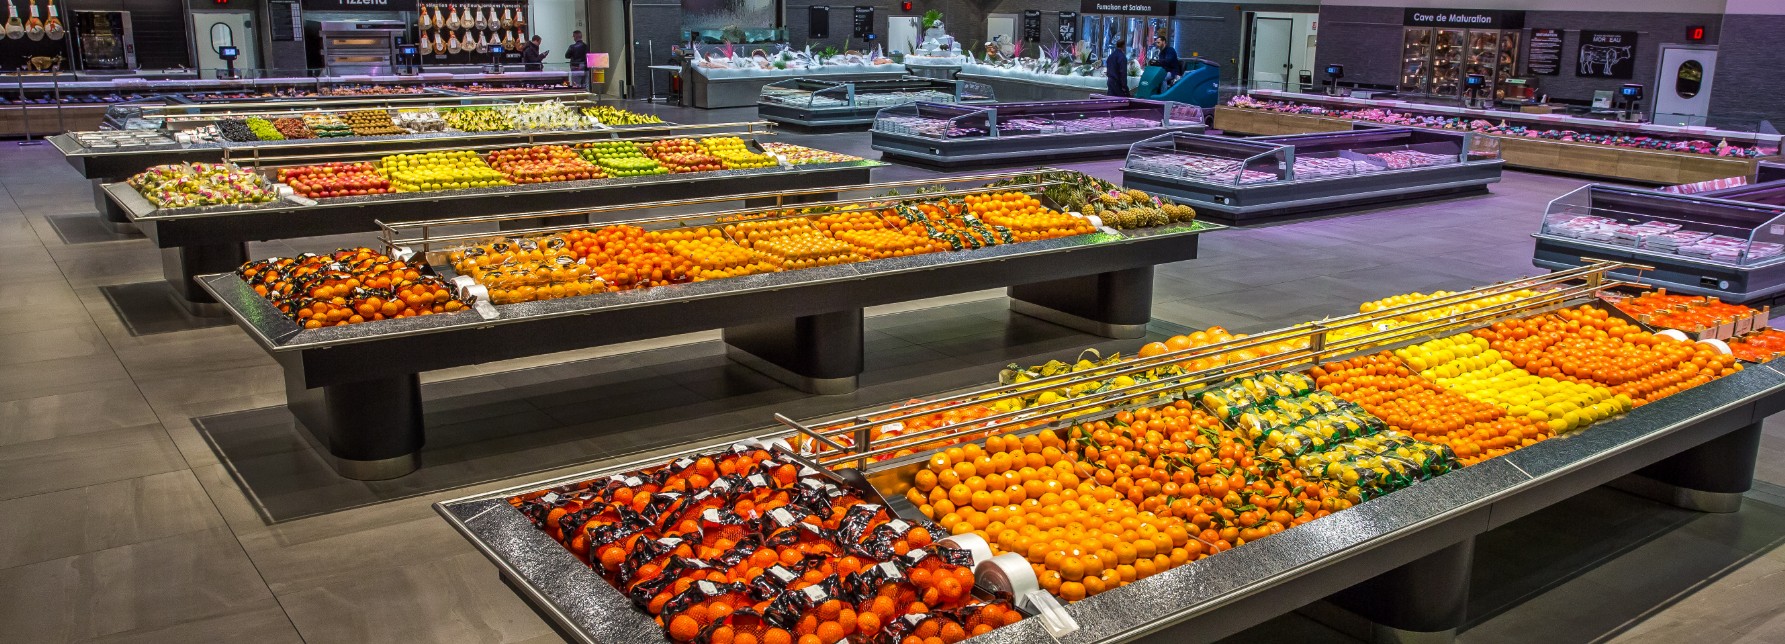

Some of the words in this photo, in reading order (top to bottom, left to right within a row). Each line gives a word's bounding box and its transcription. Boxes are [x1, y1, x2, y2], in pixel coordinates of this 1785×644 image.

[1413, 13, 1434, 21] Cave
[1436, 14, 1447, 22] de
[1448, 14, 1492, 24] Maturation
